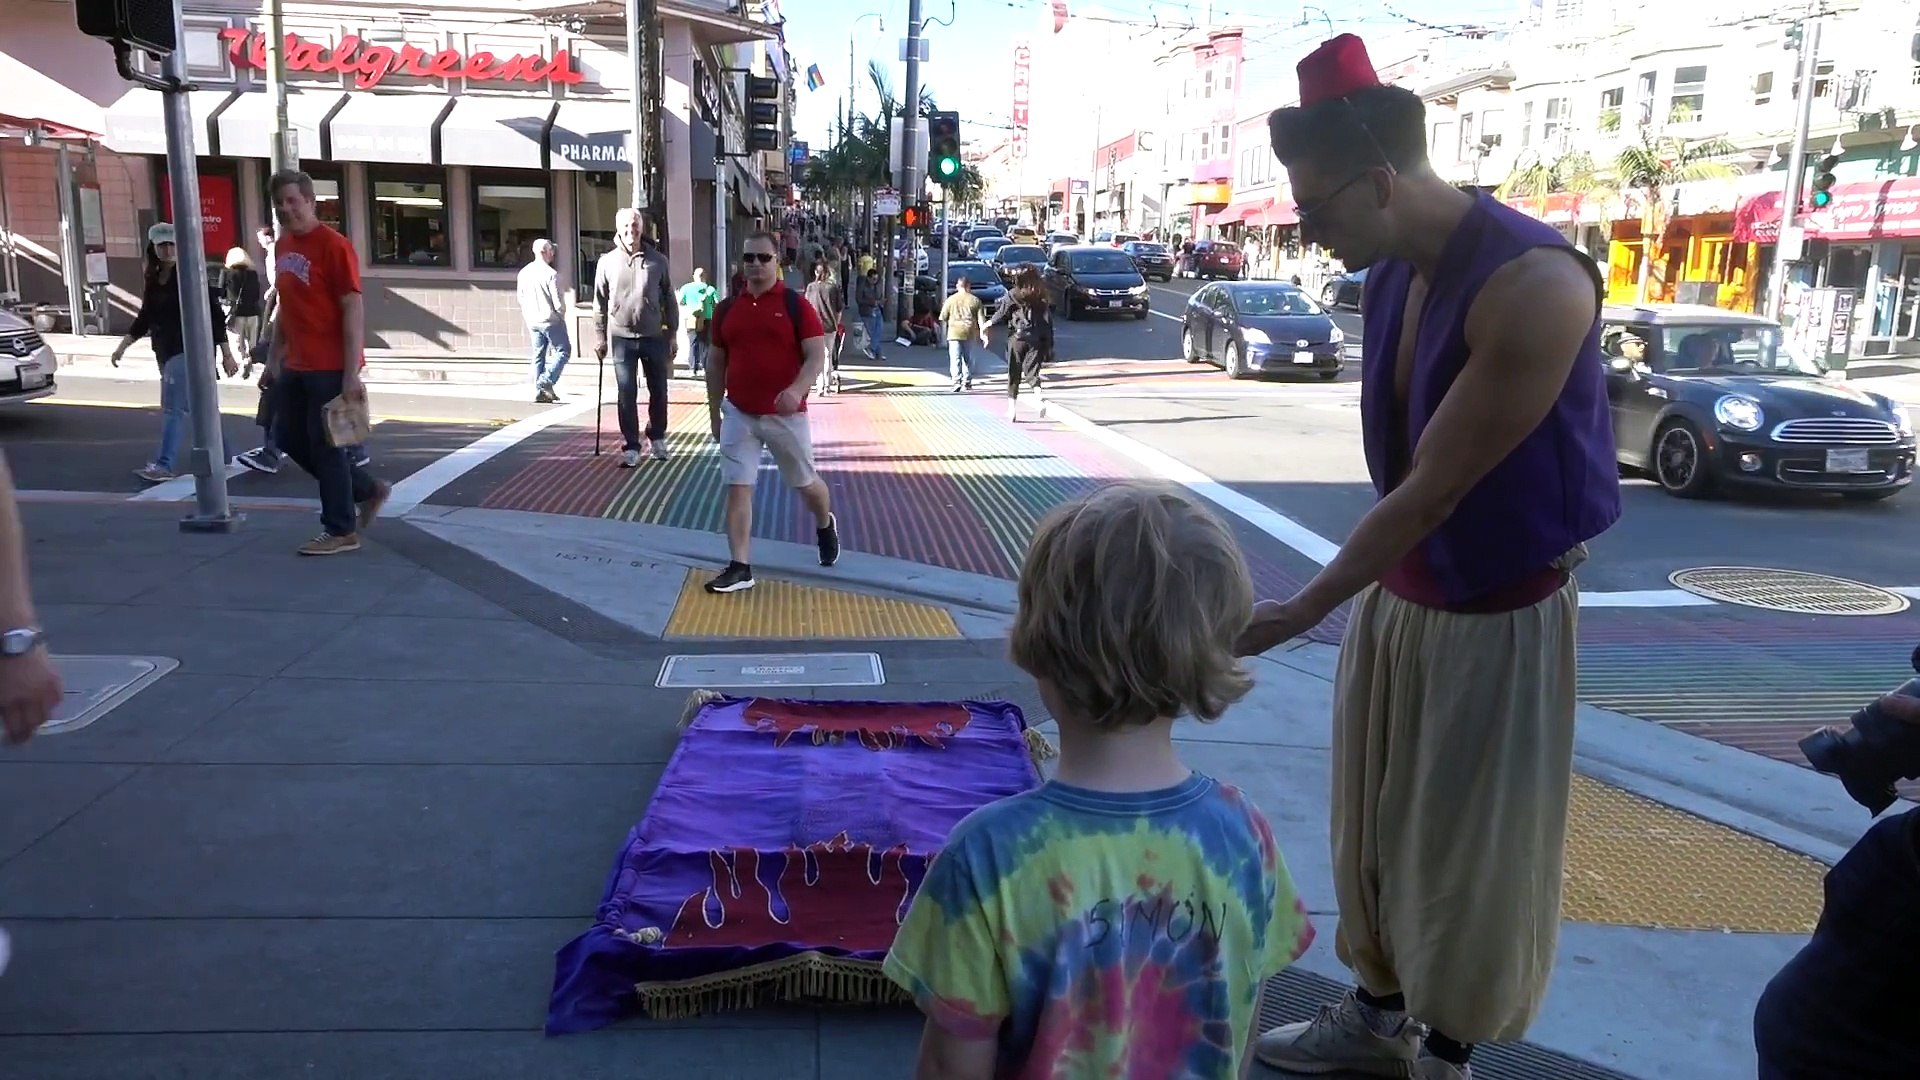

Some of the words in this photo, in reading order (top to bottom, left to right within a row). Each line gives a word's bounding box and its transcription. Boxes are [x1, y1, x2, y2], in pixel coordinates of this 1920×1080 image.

[217, 27, 584, 90] Walgreens
[560, 143, 628, 162] PHARMA
[1085, 897, 1226, 949] SIMON
